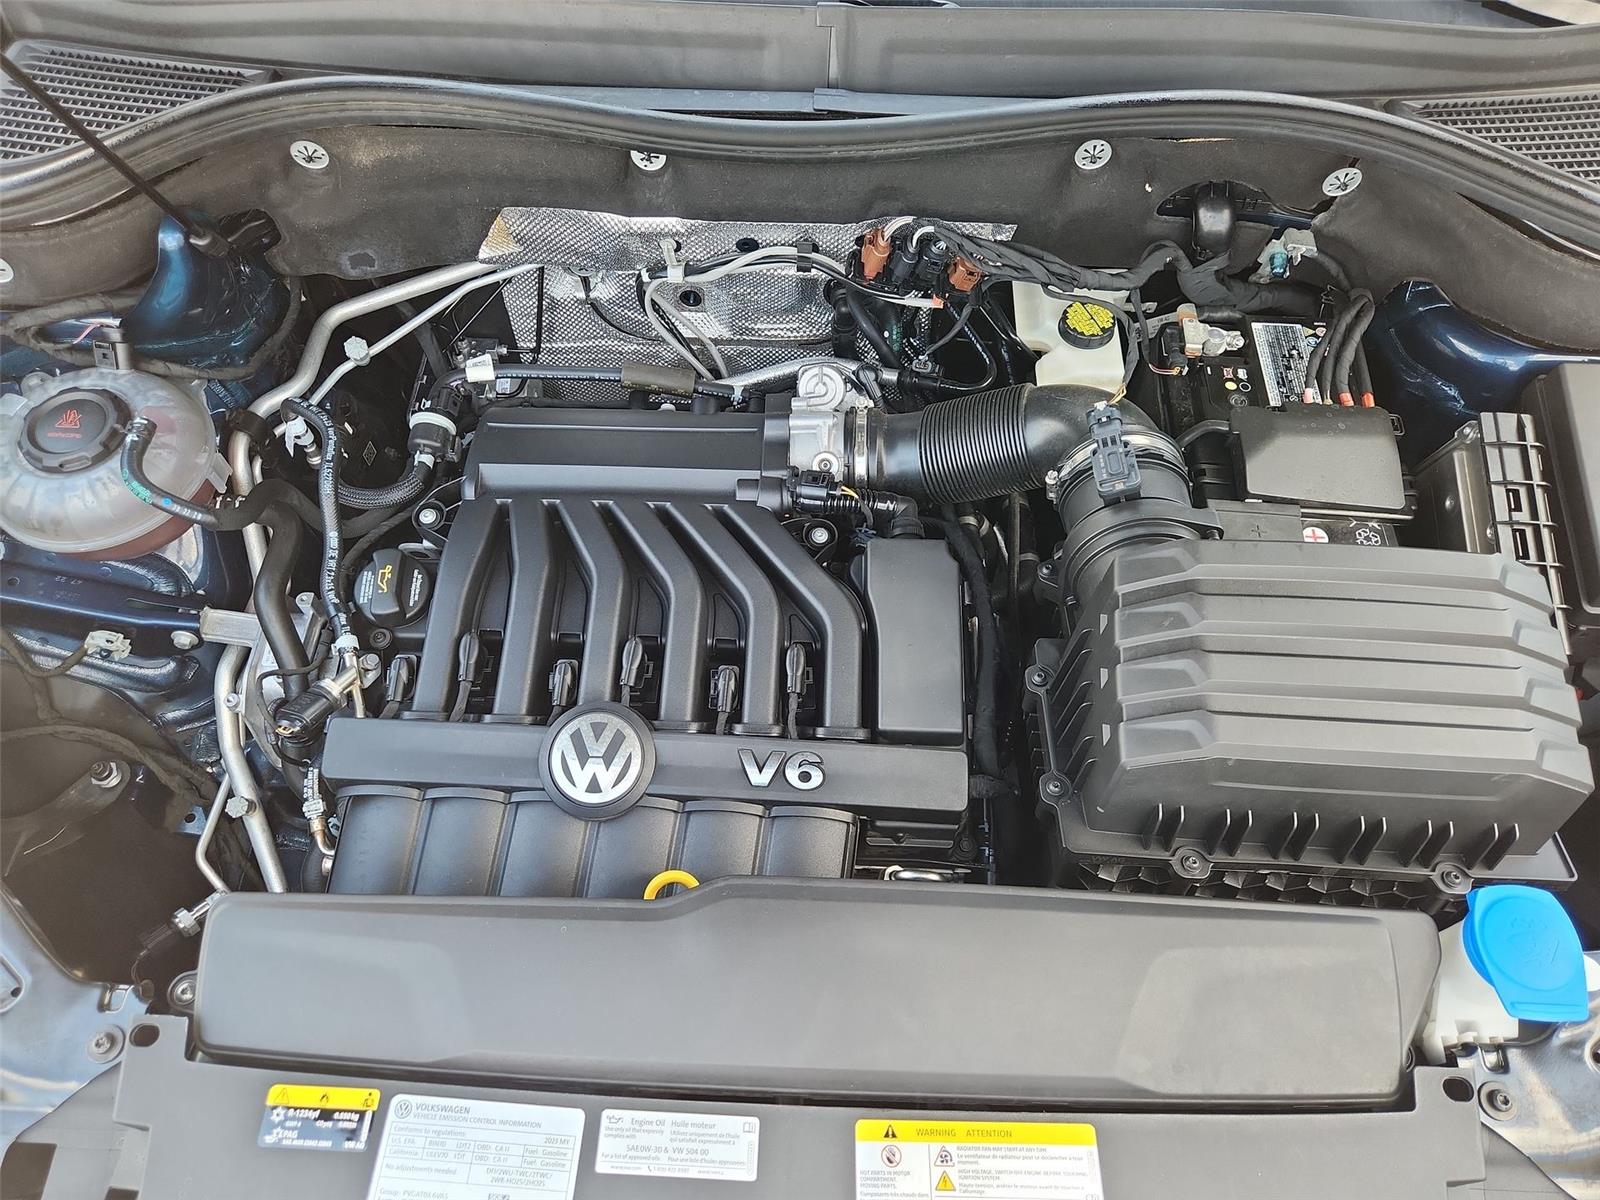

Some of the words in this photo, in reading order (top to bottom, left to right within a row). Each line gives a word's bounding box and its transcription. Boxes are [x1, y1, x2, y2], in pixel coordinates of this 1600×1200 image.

[737, 748, 827, 791] V6
[415, 1103, 471, 1114] VOLKSWAGEN
[438, 1114, 468, 1122] EMISSION
[469, 1117, 497, 1125] CONTROL
[499, 1119, 542, 1128] INFORMATION
[631, 1118, 655, 1127] Engine
[655, 1119, 666, 1127] Oil
[671, 1120, 689, 1128] Huile
[916, 1128, 957, 1137] WARNING
[966, 1129, 1013, 1138] ATTENTION
[542, 1149, 568, 1157] Gasoline
[672, 1147, 685, 1155] VW
[686, 1147, 699, 1155] 504
[700, 1148, 710, 1156] 00
[540, 1160, 567, 1168] Gasoline
